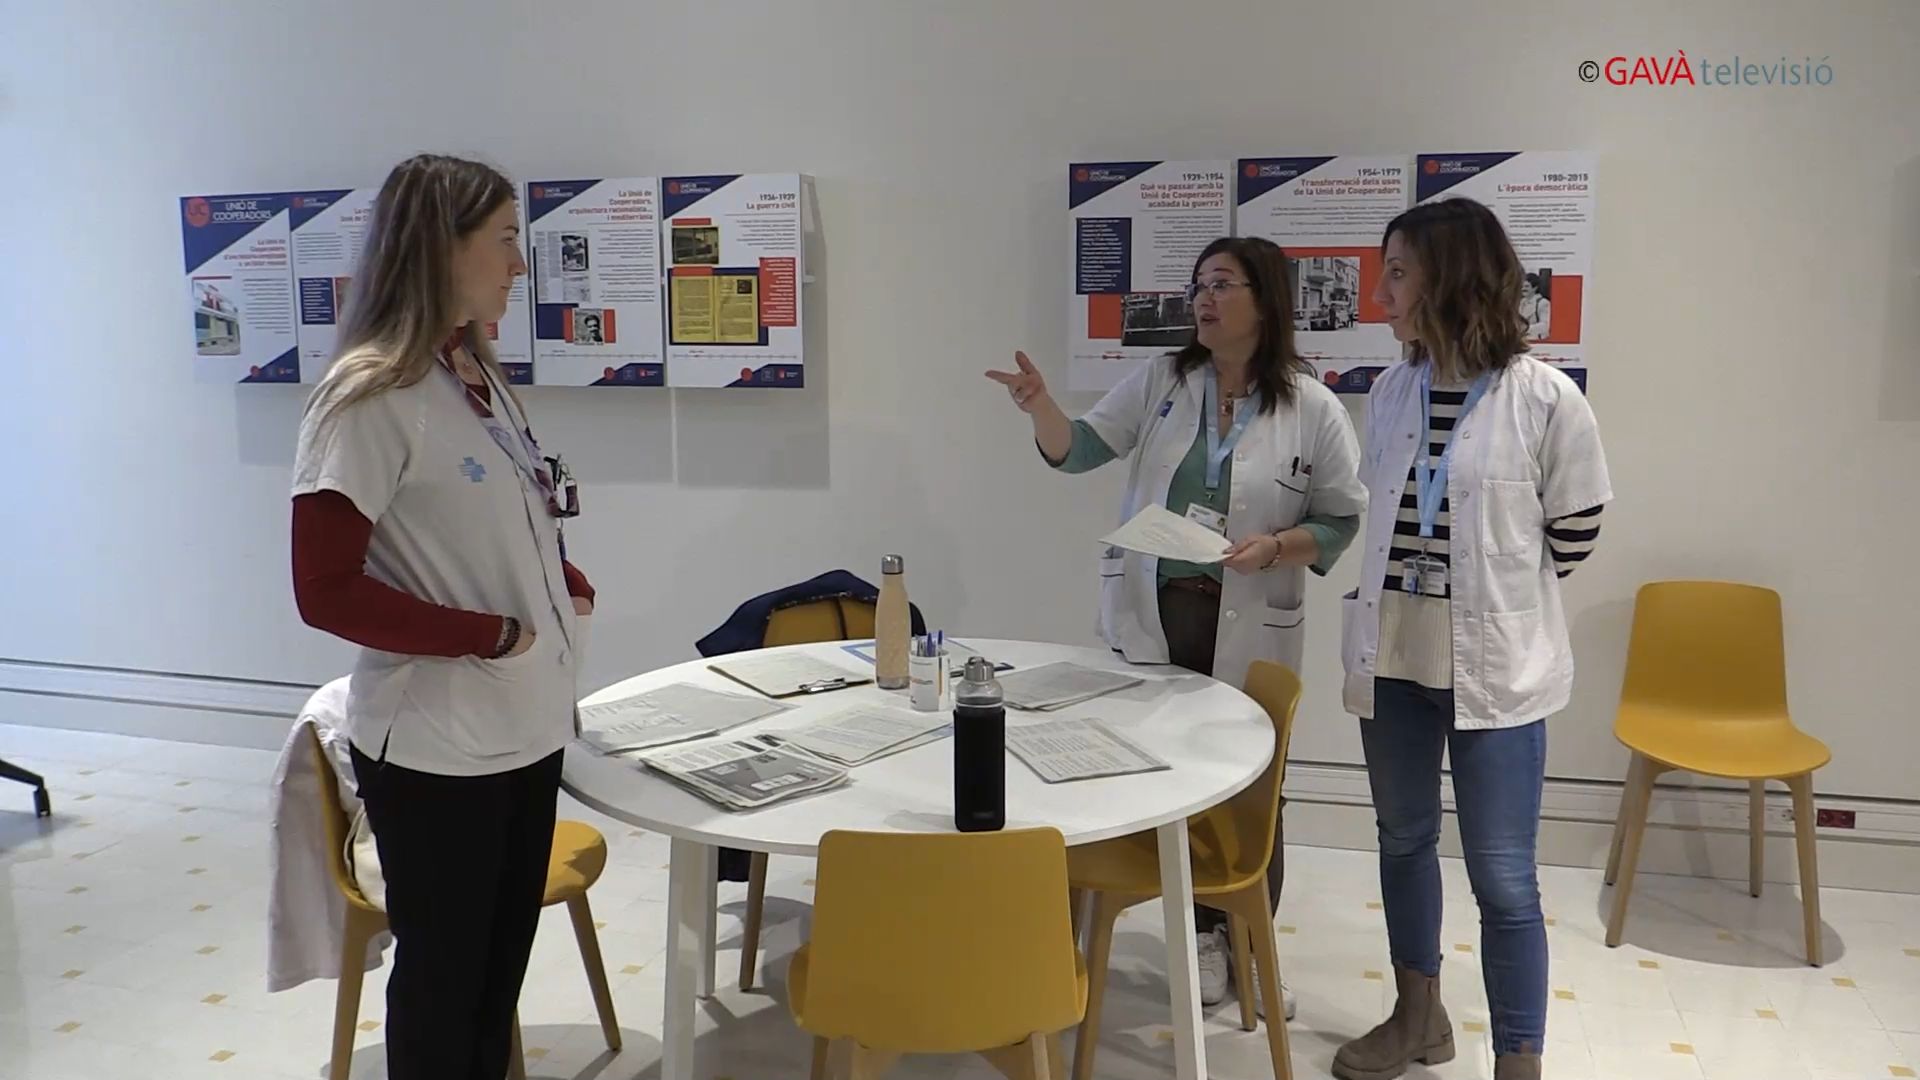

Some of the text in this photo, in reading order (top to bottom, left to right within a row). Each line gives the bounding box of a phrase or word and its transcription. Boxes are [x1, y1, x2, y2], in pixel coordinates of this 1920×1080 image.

[1182, 172, 1224, 181] 1939-1954
[1357, 168, 1401, 176] 1954-1979
[1301, 178, 1360, 186] Transformació
[1362, 178, 1380, 186] dels
[1543, 174, 1588, 182] 1980-2015
[1140, 183, 1156, 191] Què
[1197, 182, 1215, 190] amb
[1294, 186, 1401, 196] de la Unió de Cooperadors
[1498, 184, 1588, 192] L'època democràtica
[1141, 191, 1159, 200] Unió
[1172, 191, 1224, 200] Cooperadors
[247, 200, 257, 210] DE
[1148, 200, 1224, 209] acabada la guerra?
[212, 210, 272, 221] COOPERADORS
